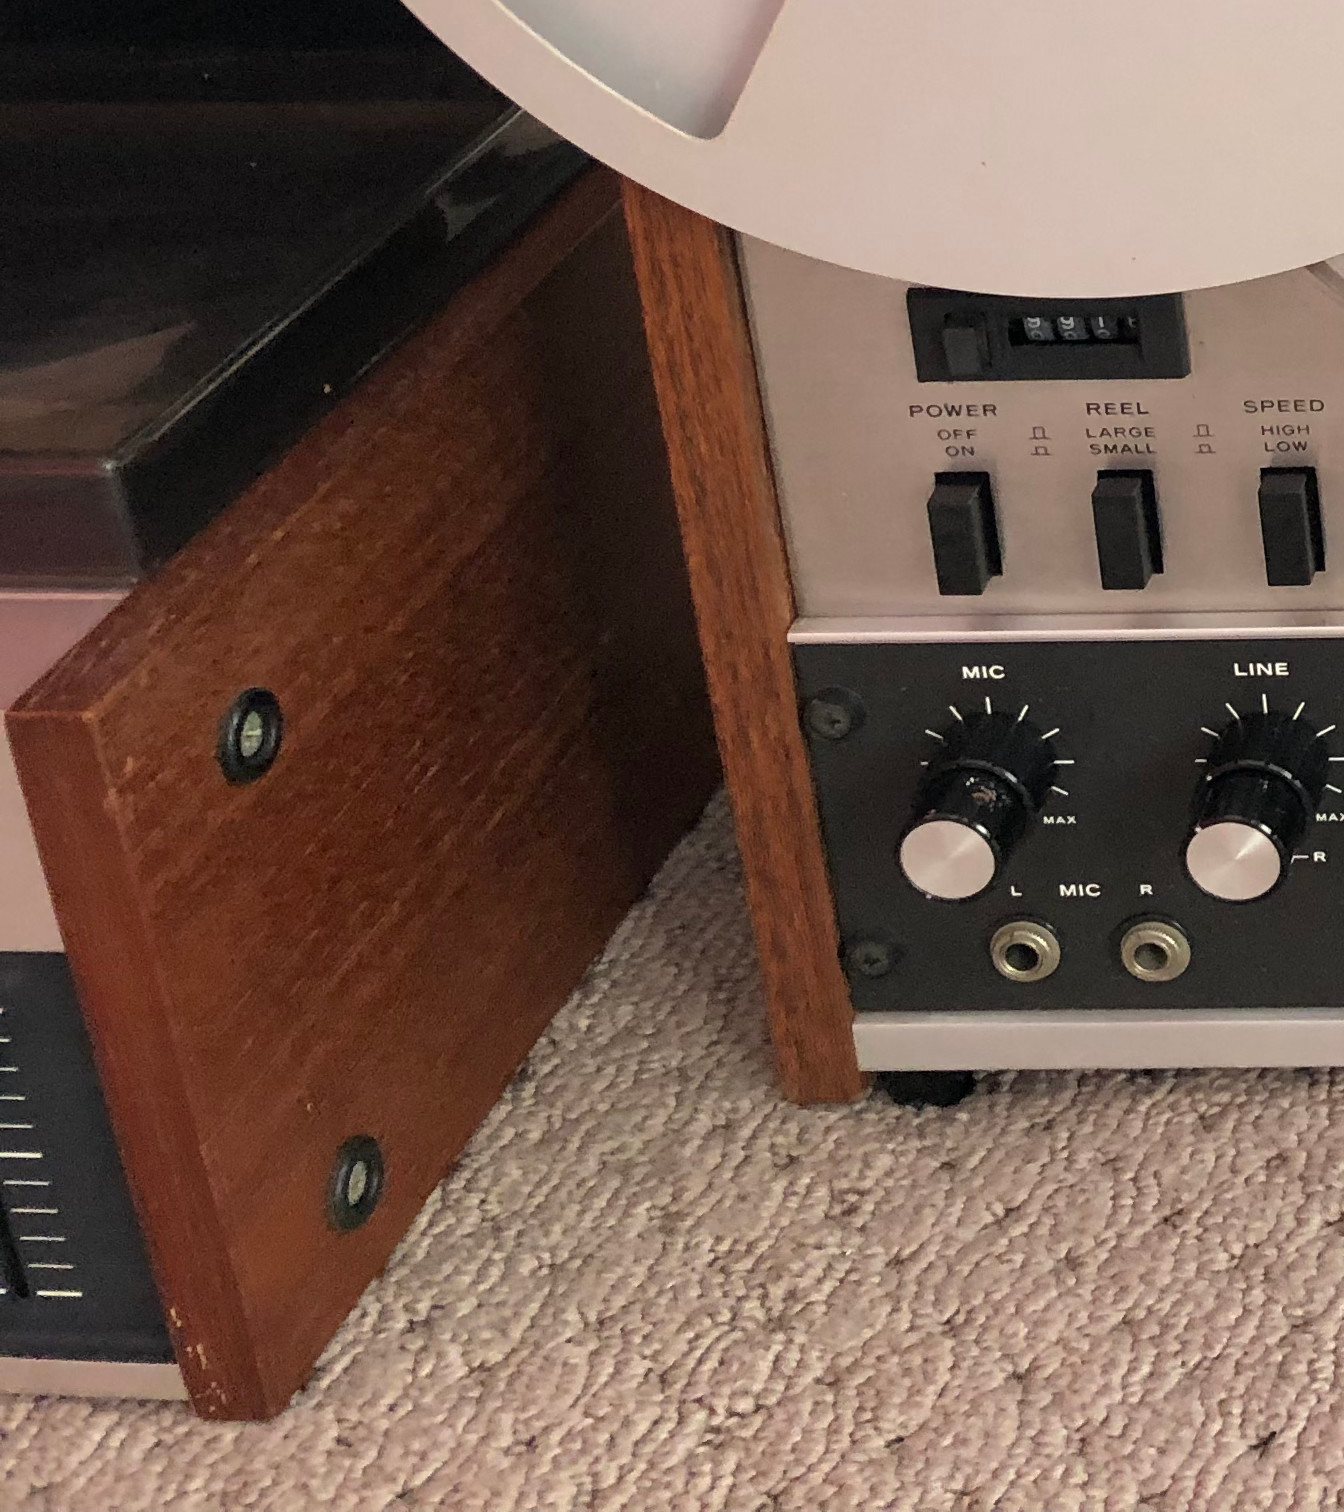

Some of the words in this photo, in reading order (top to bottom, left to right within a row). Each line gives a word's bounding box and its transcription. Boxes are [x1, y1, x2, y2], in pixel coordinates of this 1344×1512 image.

[909, 404, 996, 417] POWER
[1086, 402, 1149, 415] REEL
[1244, 400, 1324, 413] SPEED
[937, 429, 975, 440] OFF
[1086, 427, 1155, 438] LARGE
[1261, 425, 1309, 436] HIGH
[946, 446, 974, 457] ON
[1090, 443, 1155, 454] SMALL
[1265, 441, 1307, 452] LOW
[963, 666, 1004, 678] MIC
[1234, 663, 1289, 676] LINE
[1044, 816, 1076, 824] MAX
[1011, 886, 1022, 896] L
[1060, 884, 1100, 896] MIC
[1140, 885, 1152, 894] R
